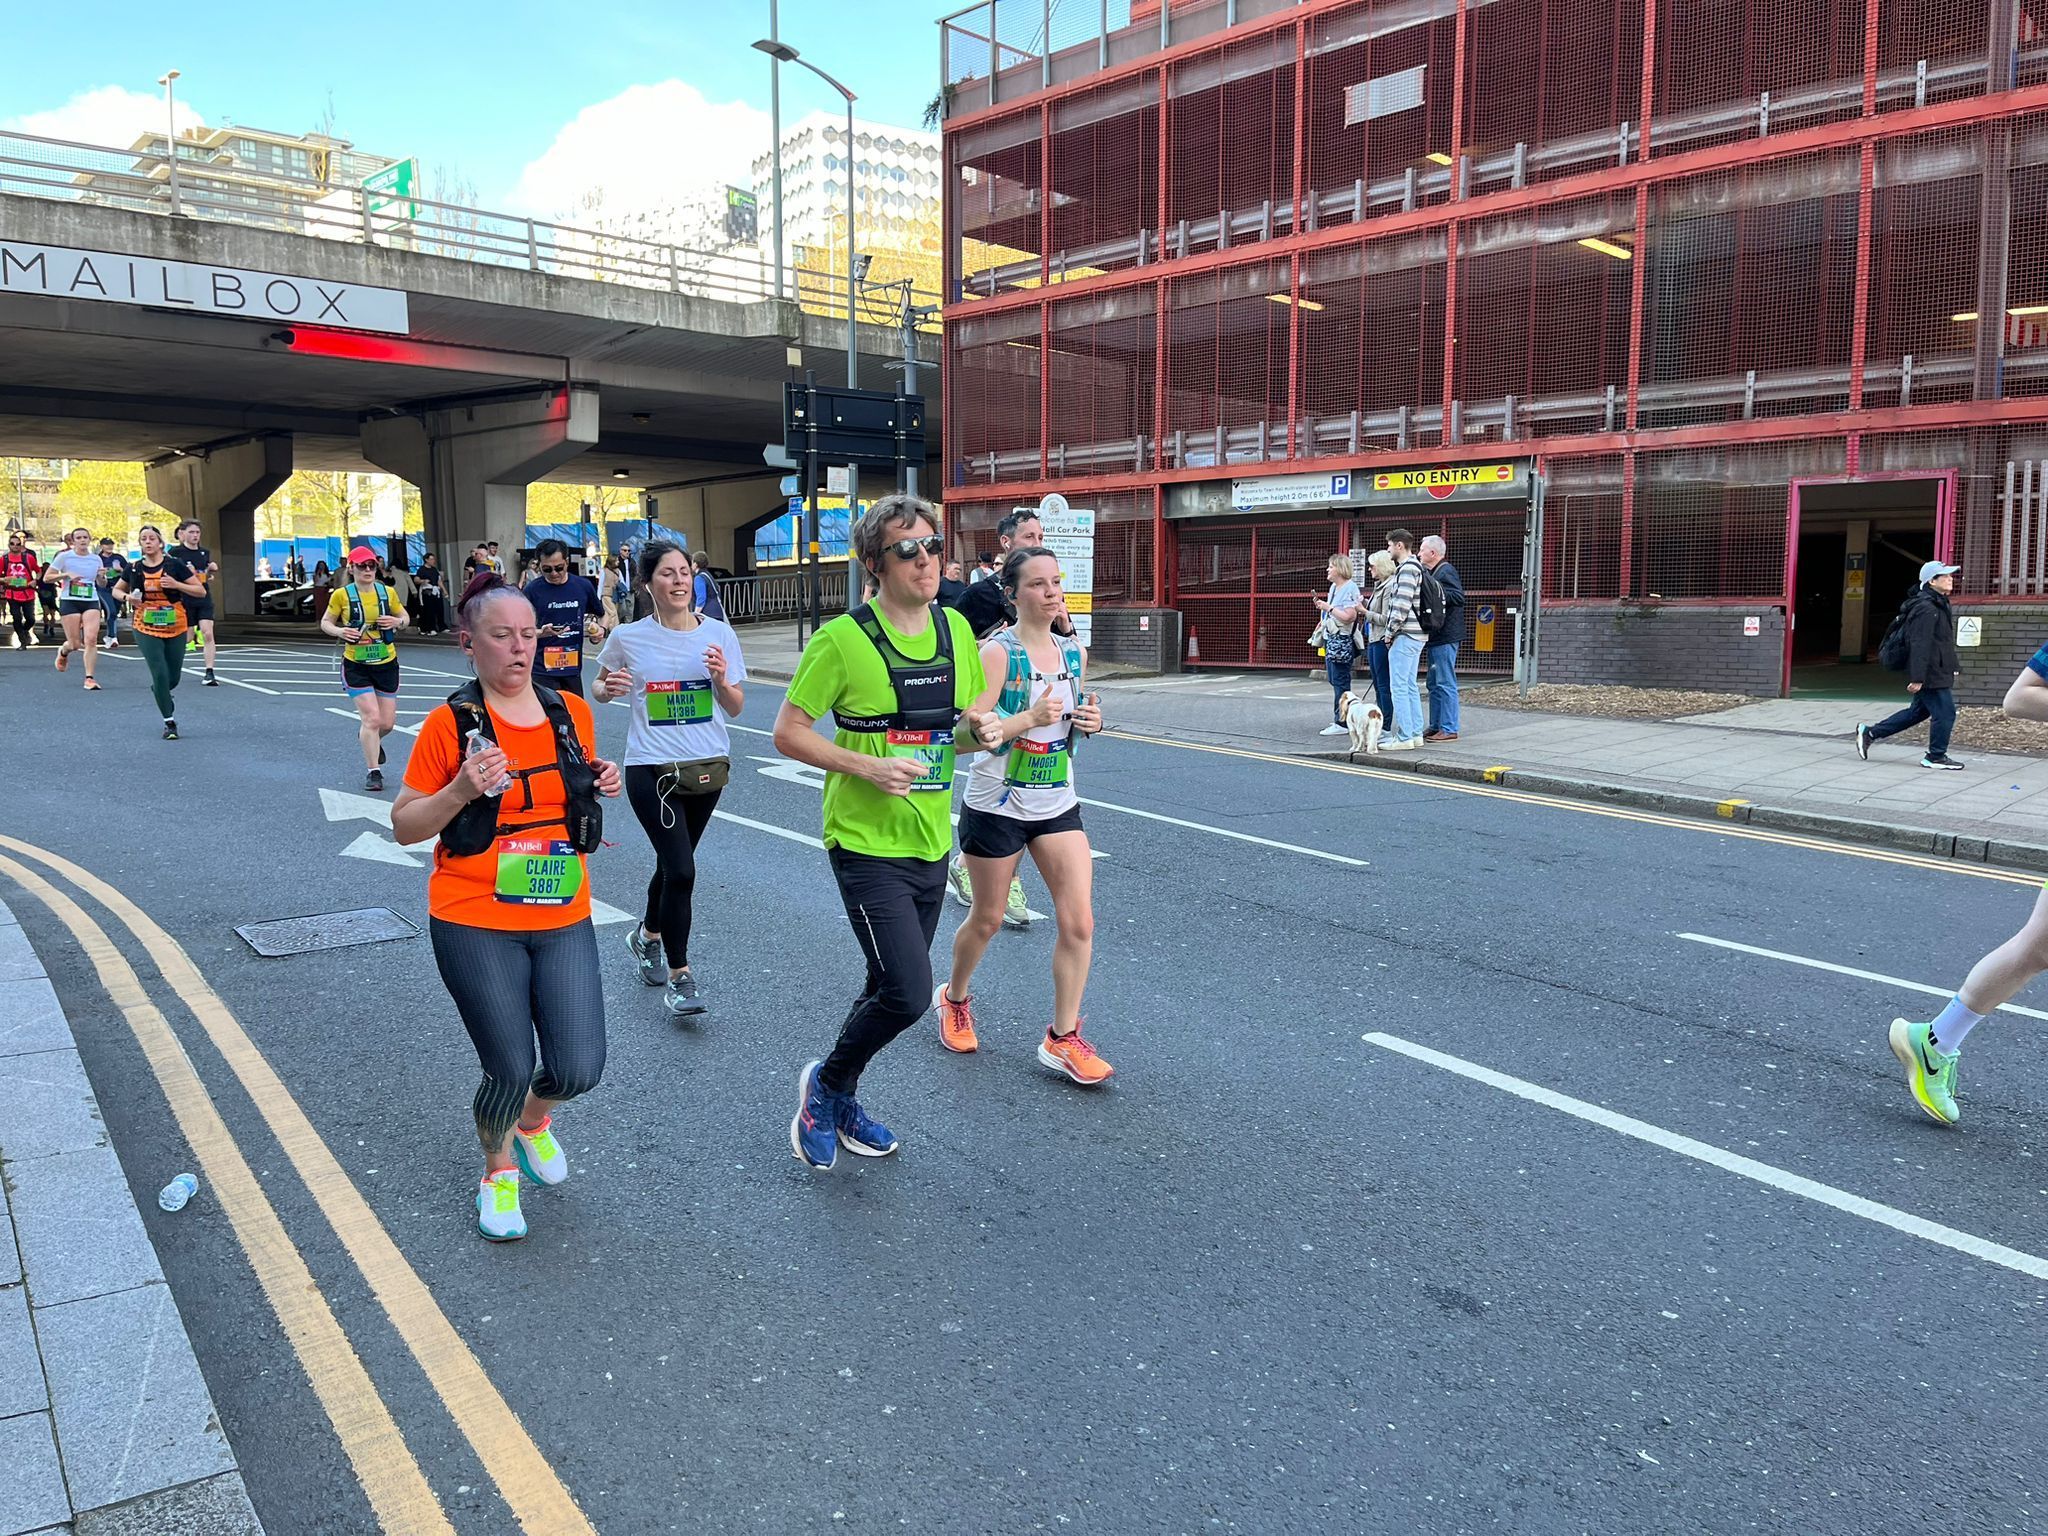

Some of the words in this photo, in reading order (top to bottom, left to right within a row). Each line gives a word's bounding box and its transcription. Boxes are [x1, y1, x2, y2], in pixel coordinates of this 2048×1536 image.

[2, 248, 348, 323] MAILBOX
[1403, 472, 1425, 485] NO
[1430, 468, 1479, 483] ENTRY
[1335, 478, 1346, 493] P
[1270, 493, 1290, 501] height
[548, 601, 579, 609] #TeamUoB
[904, 675, 948, 687] PRORUNX
[666, 694, 695, 706] MARIA
[840, 716, 889, 728] PRORUNX
[914, 748, 944, 763] ADAM
[1028, 755, 1057, 768] IMOGEN
[1030, 769, 1052, 781] 5411
[526, 859, 566, 876] CLAIRE
[529, 877, 561, 894] 3887
